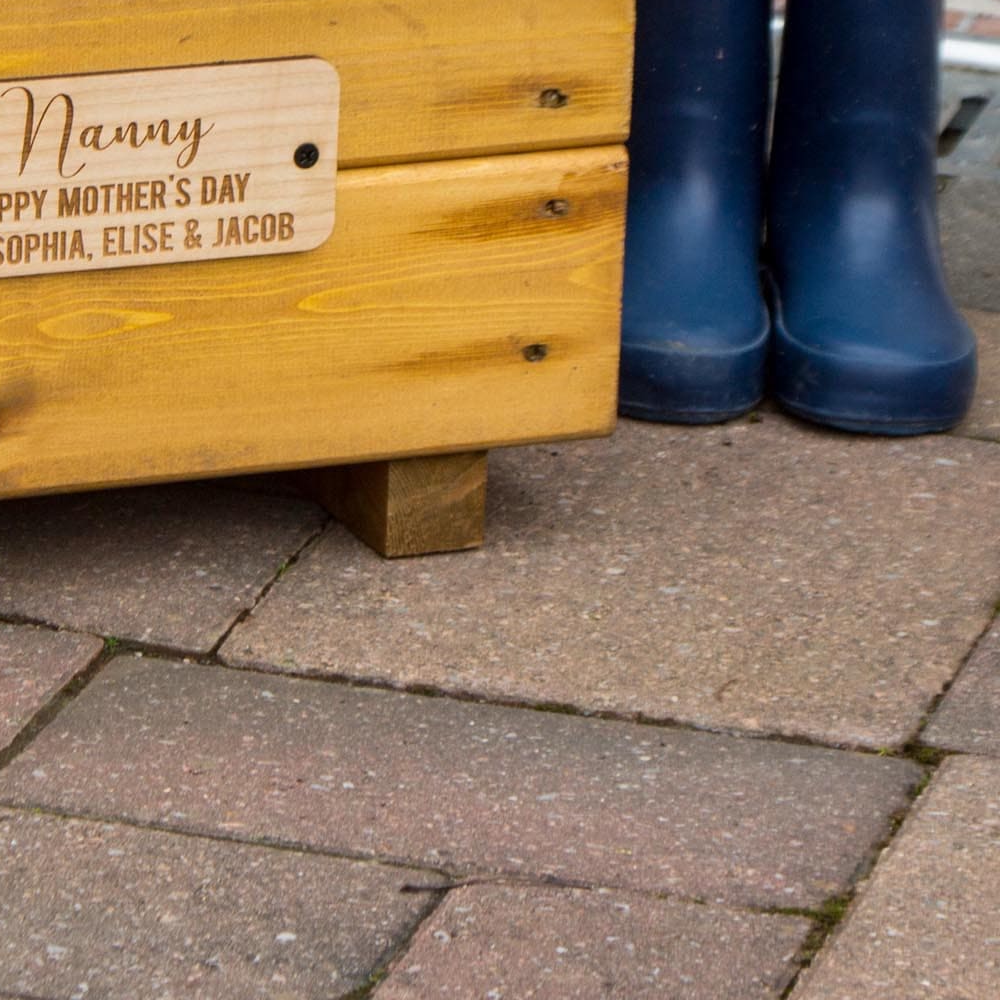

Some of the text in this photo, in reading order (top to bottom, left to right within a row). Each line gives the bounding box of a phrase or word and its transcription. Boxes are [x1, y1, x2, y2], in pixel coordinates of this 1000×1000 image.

[0, 86, 215, 179] Nanny
[57, 175, 192, 218] MOTHER'S
[201, 173, 252, 205] DAY
[102, 221, 175, 257] ELISE
[183, 219, 202, 249] &
[212, 211, 295, 247] JACOB
